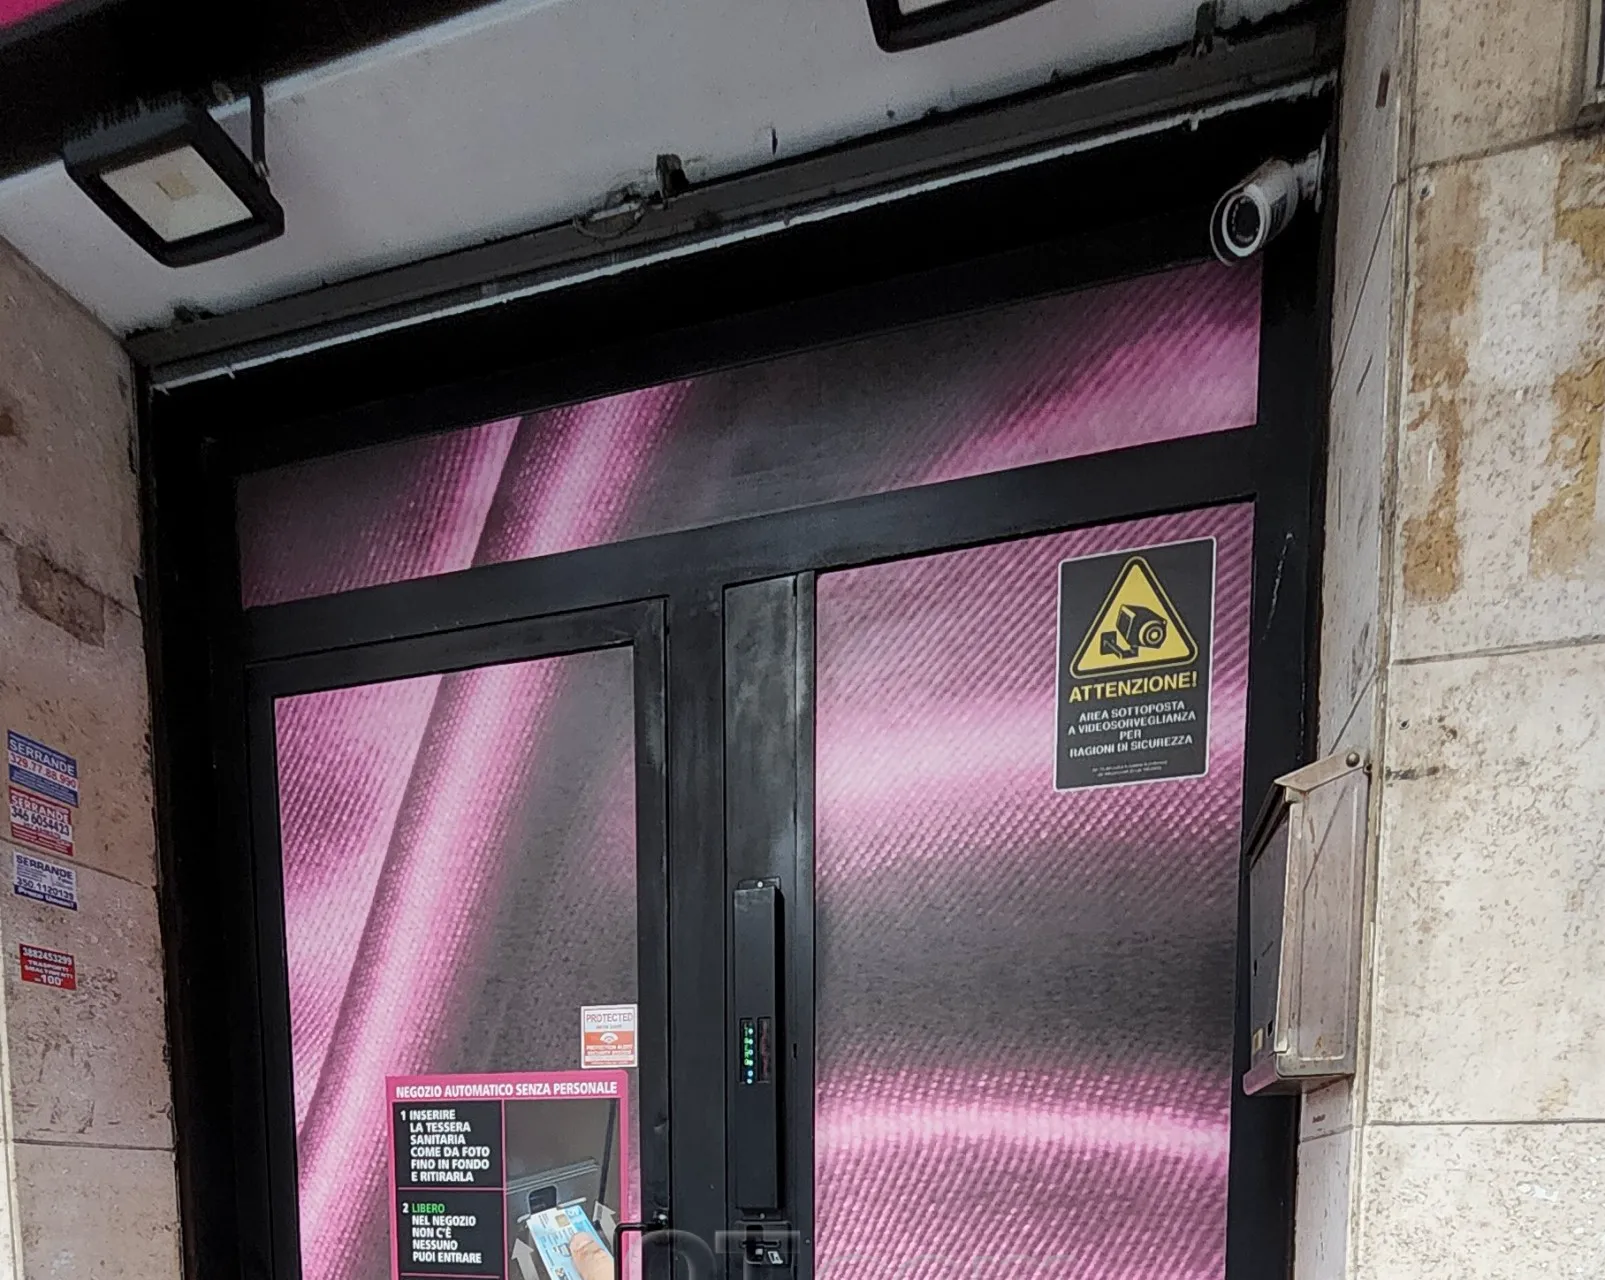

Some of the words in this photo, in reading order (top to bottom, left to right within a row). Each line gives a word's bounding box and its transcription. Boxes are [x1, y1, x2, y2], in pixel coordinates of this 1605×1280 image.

[1068, 671, 1197, 703] ATTENZIONE!
[1079, 709, 1109, 723] AREA
[1111, 700, 1185, 719] SOTTOPOSTA
[1067, 725, 1076, 736] A
[1078, 710, 1196, 734] VIDEOSORVEGLIANZA
[1119, 729, 1141, 740] PER
[1069, 743, 1115, 758] RAGIONI
[1117, 741, 1128, 753] DI
[1130, 734, 1193, 751] SICUREZZA
[9, 739, 75, 776] SERRANDE
[11, 794, 69, 824] SERRANDE
[16, 855, 73, 880] SERRANDE
[586, 1012, 632, 1023] PROTECTED
[396, 1085, 442, 1098] NEGOZIO
[444, 1083, 513, 1097] AUTOMATICO
[516, 1083, 551, 1095] SENZA
[553, 1081, 617, 1095] PERSONALE
[400, 1110, 406, 1120] 1
[409, 1109, 456, 1120] INSERIRE
[410, 1122, 423, 1133] LA
[426, 1121, 471, 1132] TESSERA
[410, 1134, 466, 1145] SANITARIA
[410, 1146, 441, 1157] COME
[443, 1146, 460, 1157] DA
[462, 1146, 490, 1157] FOTO
[411, 1159, 436, 1169] FINO
[438, 1159, 449, 1169] IN
[452, 1159, 490, 1169] FONDO
[411, 1171, 418, 1181] E
[420, 1171, 474, 1182] RITIRARLA
[402, 1203, 409, 1213] 2
[412, 1203, 445, 1213] LIBERO
[412, 1215, 430, 1225] NEL
[432, 1215, 476, 1226] NEGOZIO
[412, 1227, 434, 1237] NON
[436, 1226, 452, 1238] C'È
[412, 1239, 458, 1250] NESSUNO
[413, 1251, 436, 1262] PUOI
[438, 1252, 482, 1263] ENTRARE
